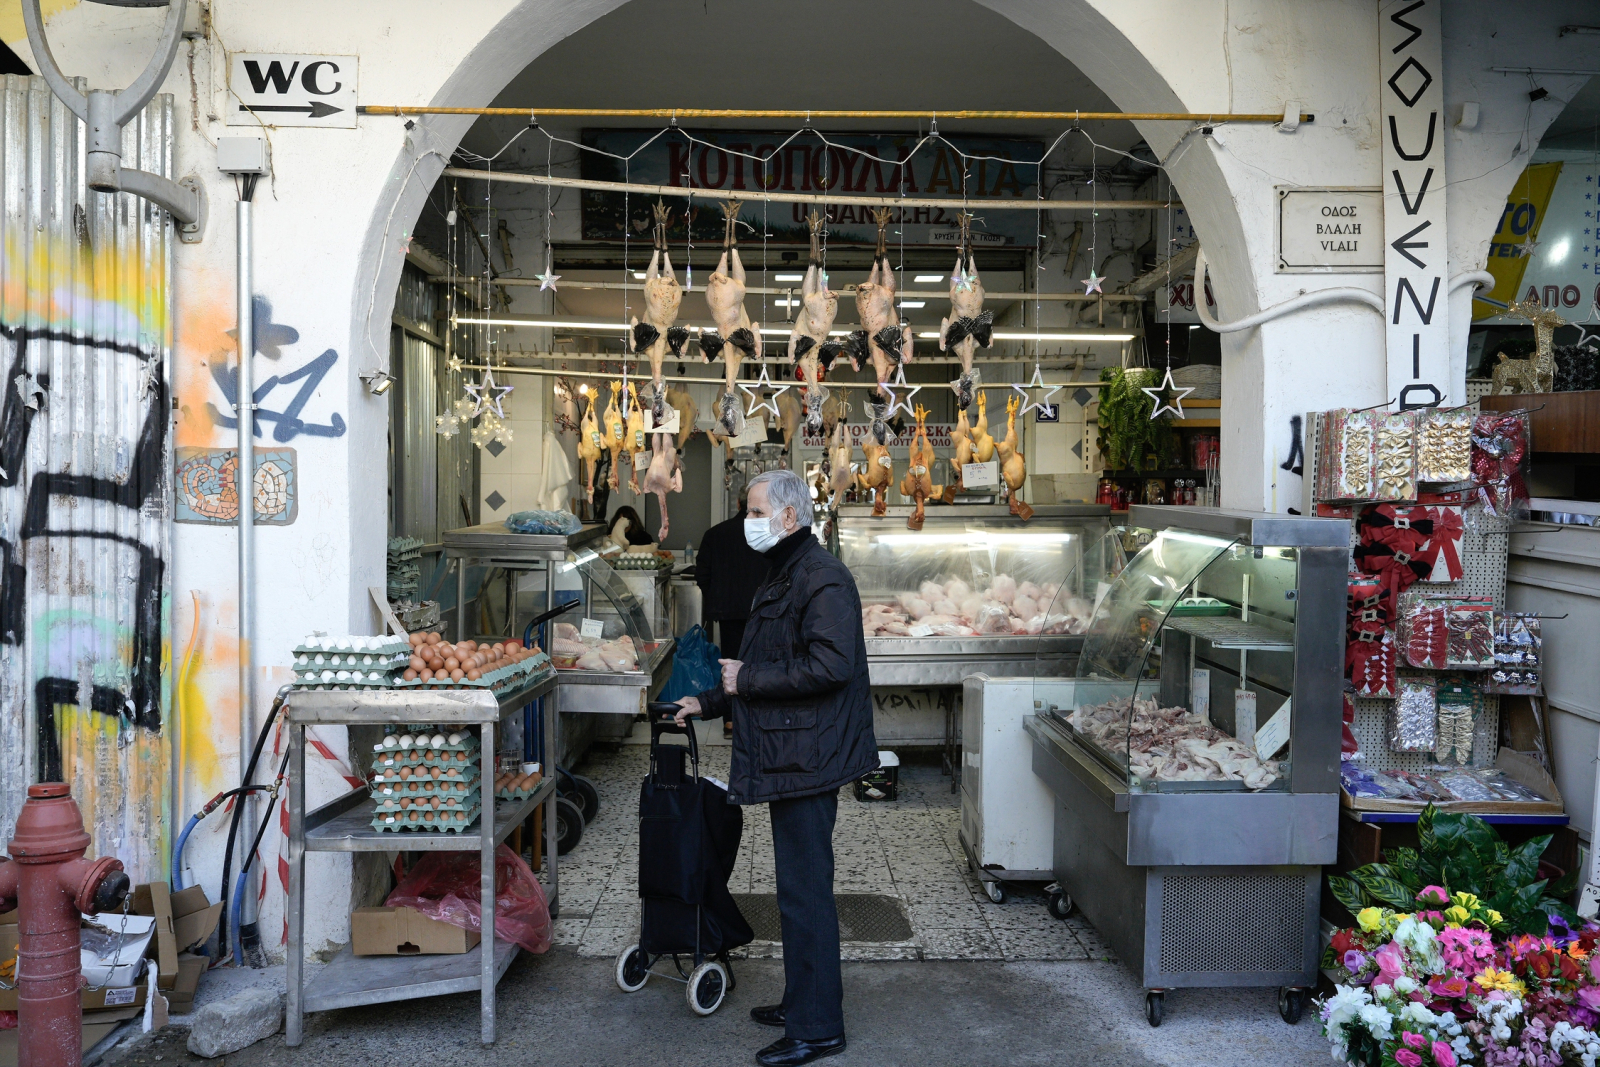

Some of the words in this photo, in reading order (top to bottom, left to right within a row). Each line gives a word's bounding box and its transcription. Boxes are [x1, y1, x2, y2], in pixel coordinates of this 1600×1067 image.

[243, 60, 342, 95] WC
[666, 142, 918, 194] ΚΟΤΟΠΟΥΛΑ
[1321, 206, 1357, 217] ΟΔΟΣ
[1316, 223, 1361, 235] ΒΛΑΛΗ
[1320, 241, 1358, 251] VLALI
